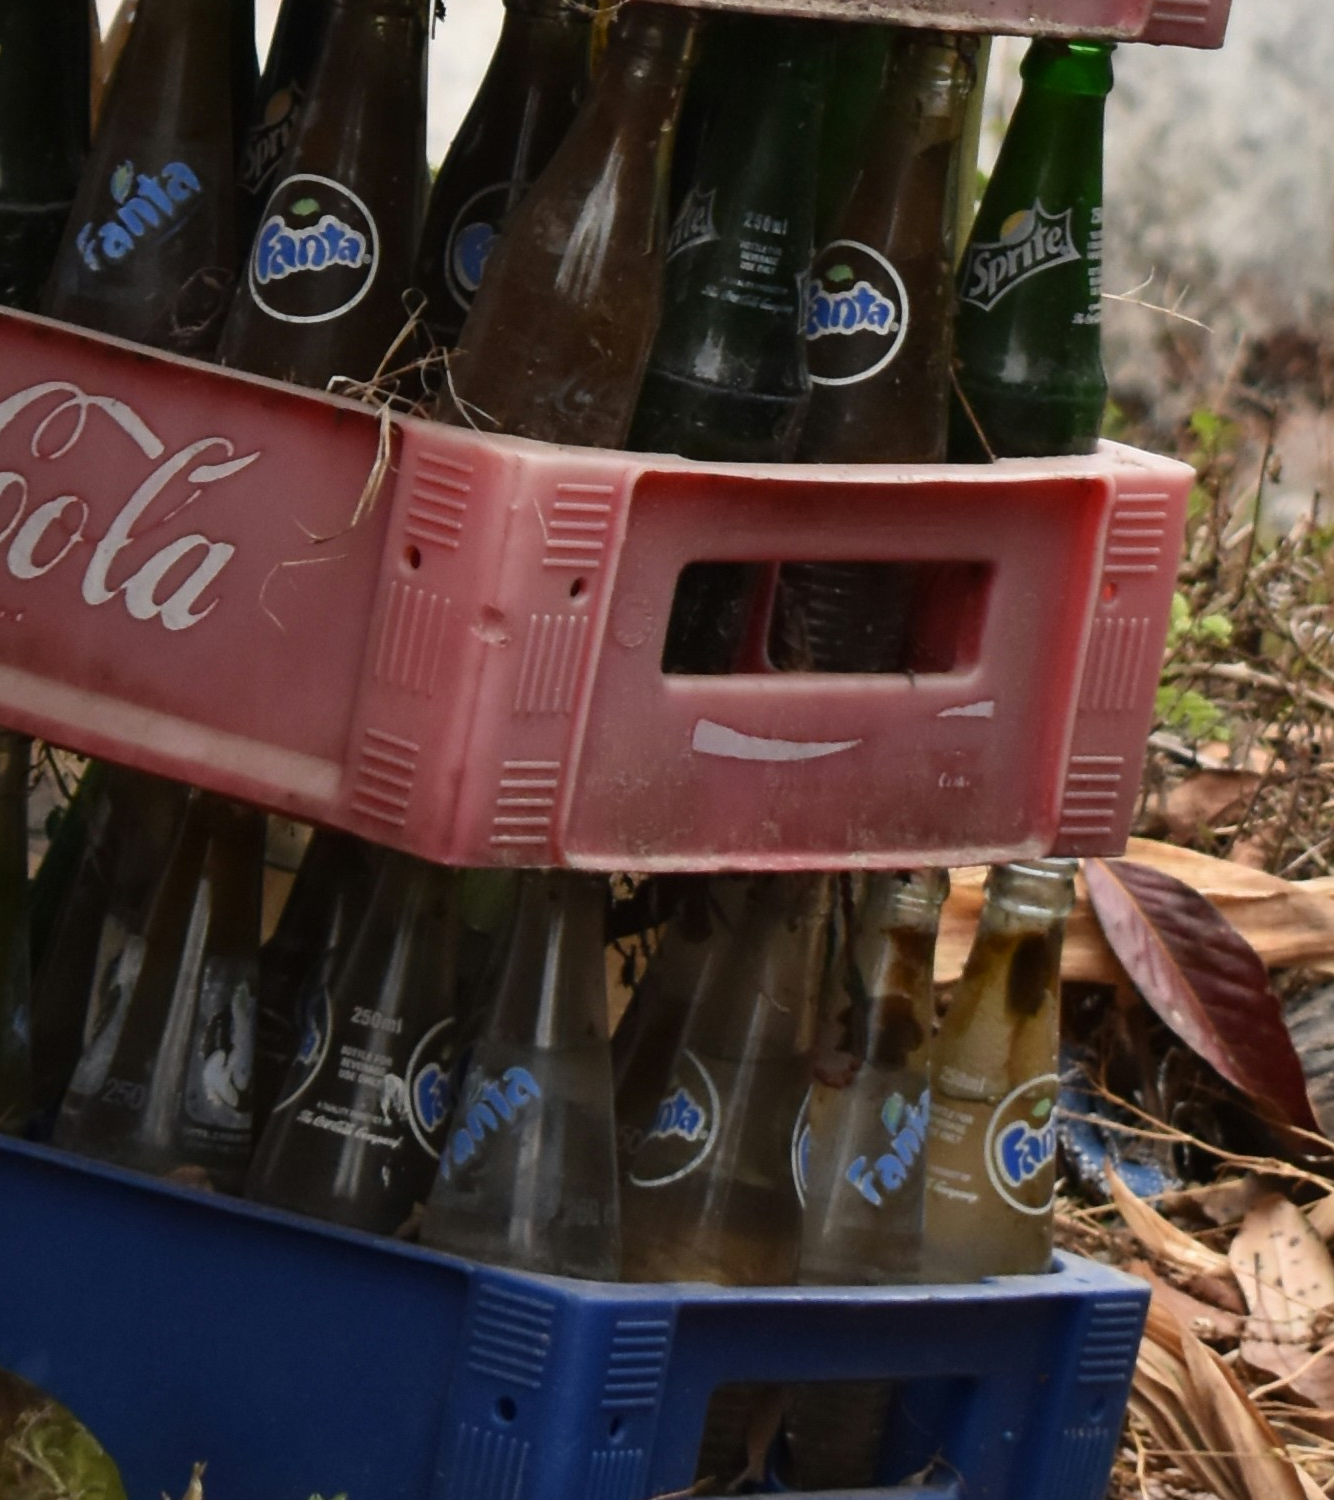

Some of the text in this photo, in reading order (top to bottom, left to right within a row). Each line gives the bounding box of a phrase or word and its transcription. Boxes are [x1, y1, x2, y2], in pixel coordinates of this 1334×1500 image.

[75, 160, 203, 267] Fanta
[257, 220, 365, 283] Fanta
[968, 222, 1063, 298] Sprite
[350, 1006, 403, 1035] 250ml
